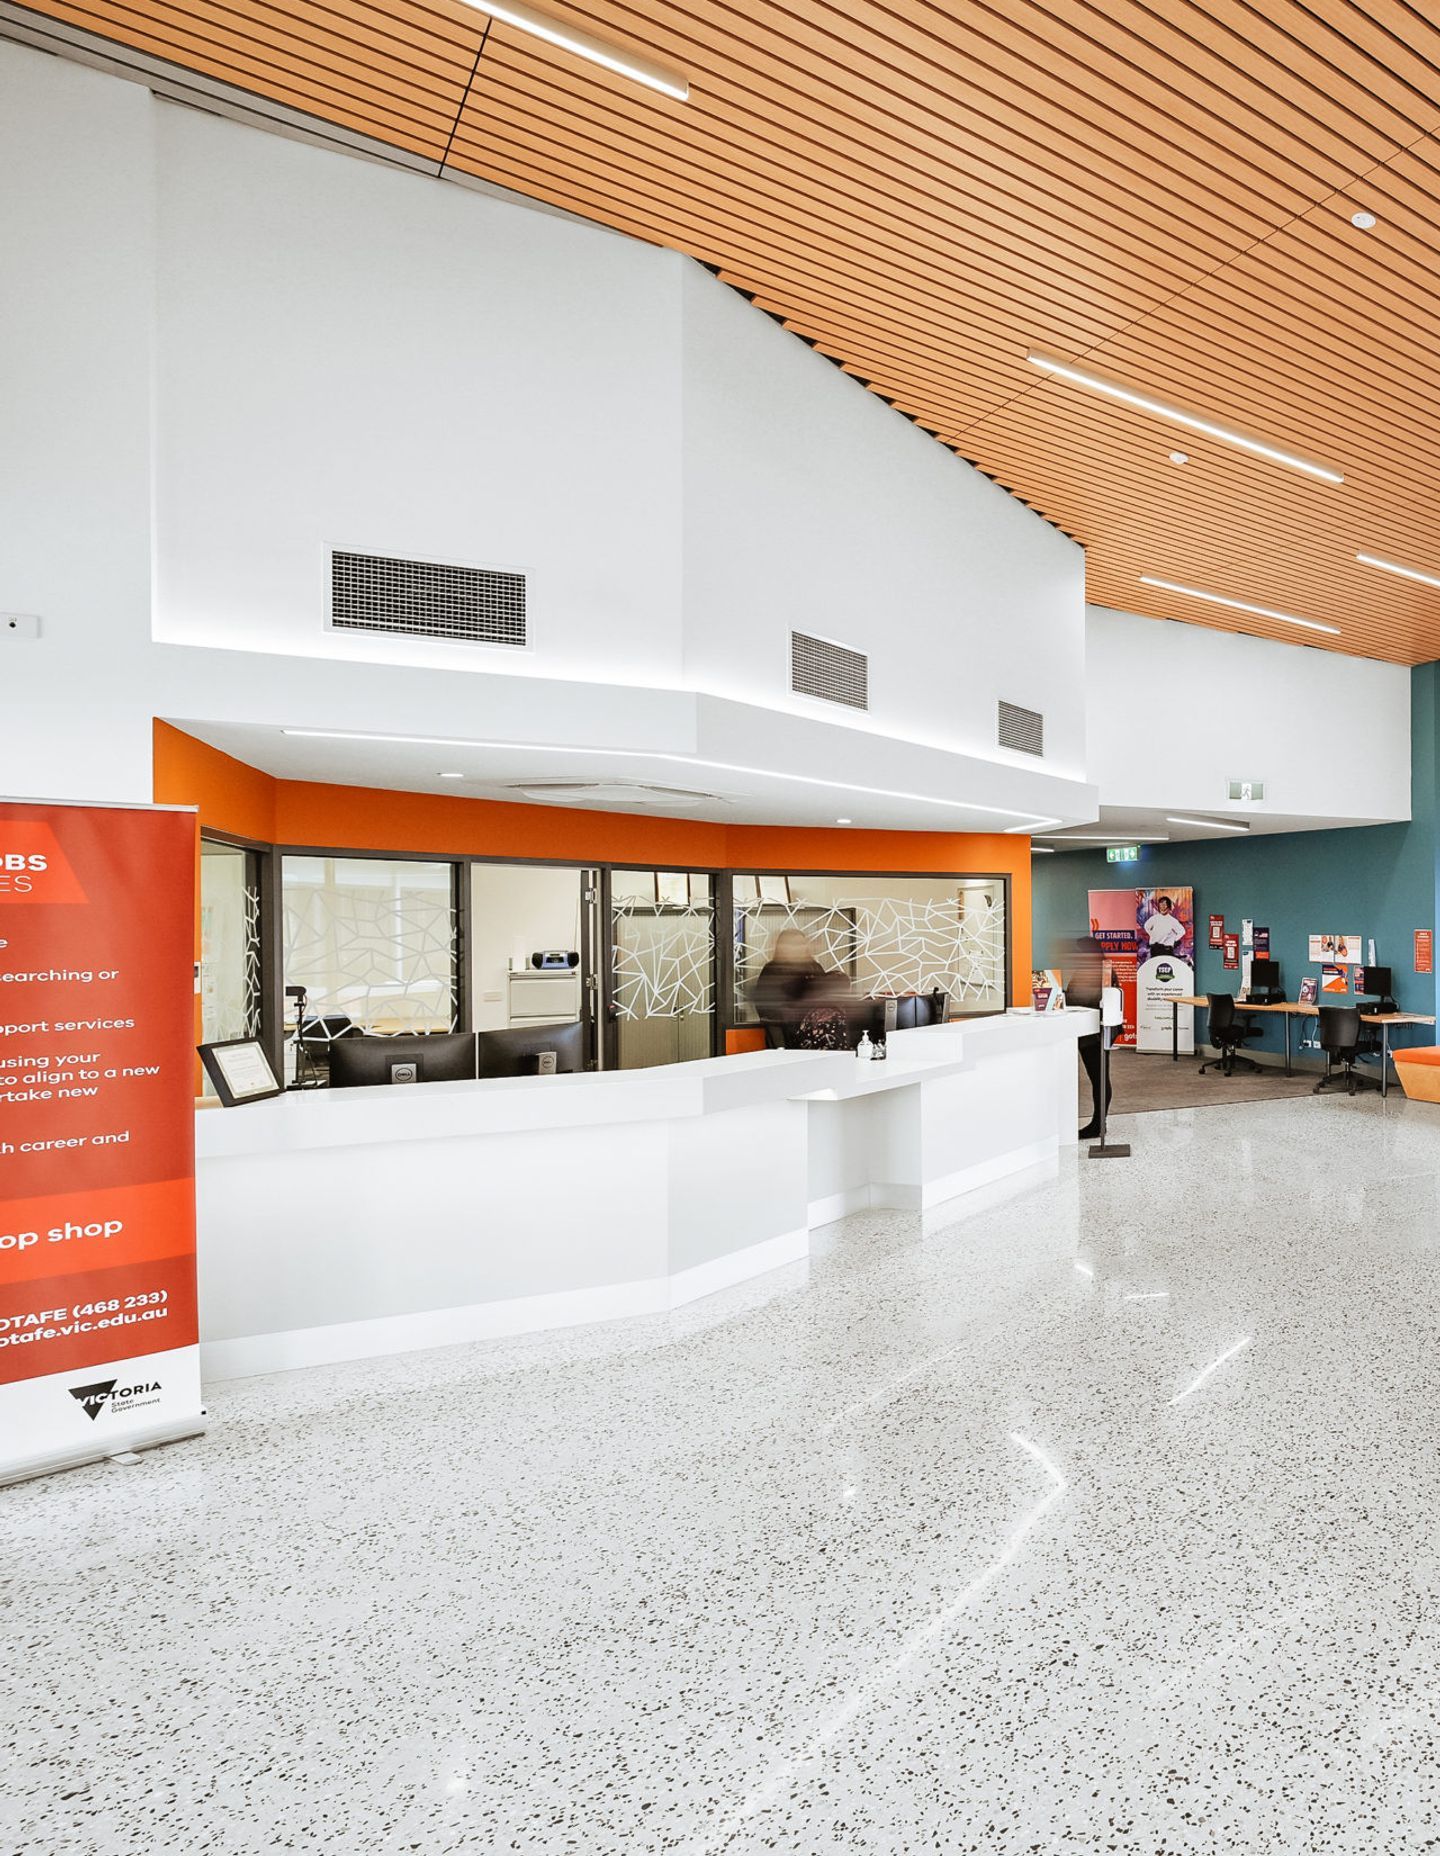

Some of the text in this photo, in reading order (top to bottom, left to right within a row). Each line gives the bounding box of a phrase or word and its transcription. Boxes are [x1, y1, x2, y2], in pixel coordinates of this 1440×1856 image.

[0, 853, 48, 872] BS
[1094, 931, 1133, 940] GET STARTED.
[1100, 941, 1120, 951] PPLY
[0, 969, 119, 983] earching or
[54, 1018, 135, 1032] services
[55, 1053, 101, 1067] your
[22, 1071, 74, 1084] align
[78, 1068, 100, 1080] to
[104, 1067, 117, 1079] a
[122, 1065, 160, 1077] new
[58, 1086, 99, 1098] new
[0, 1130, 130, 1155] h career and
[0, 1219, 123, 1251] op shop
[72, 1299, 120, 1319] (468
[124, 1289, 169, 1309] 233)
[77, 1381, 163, 1407] VICTORIA
